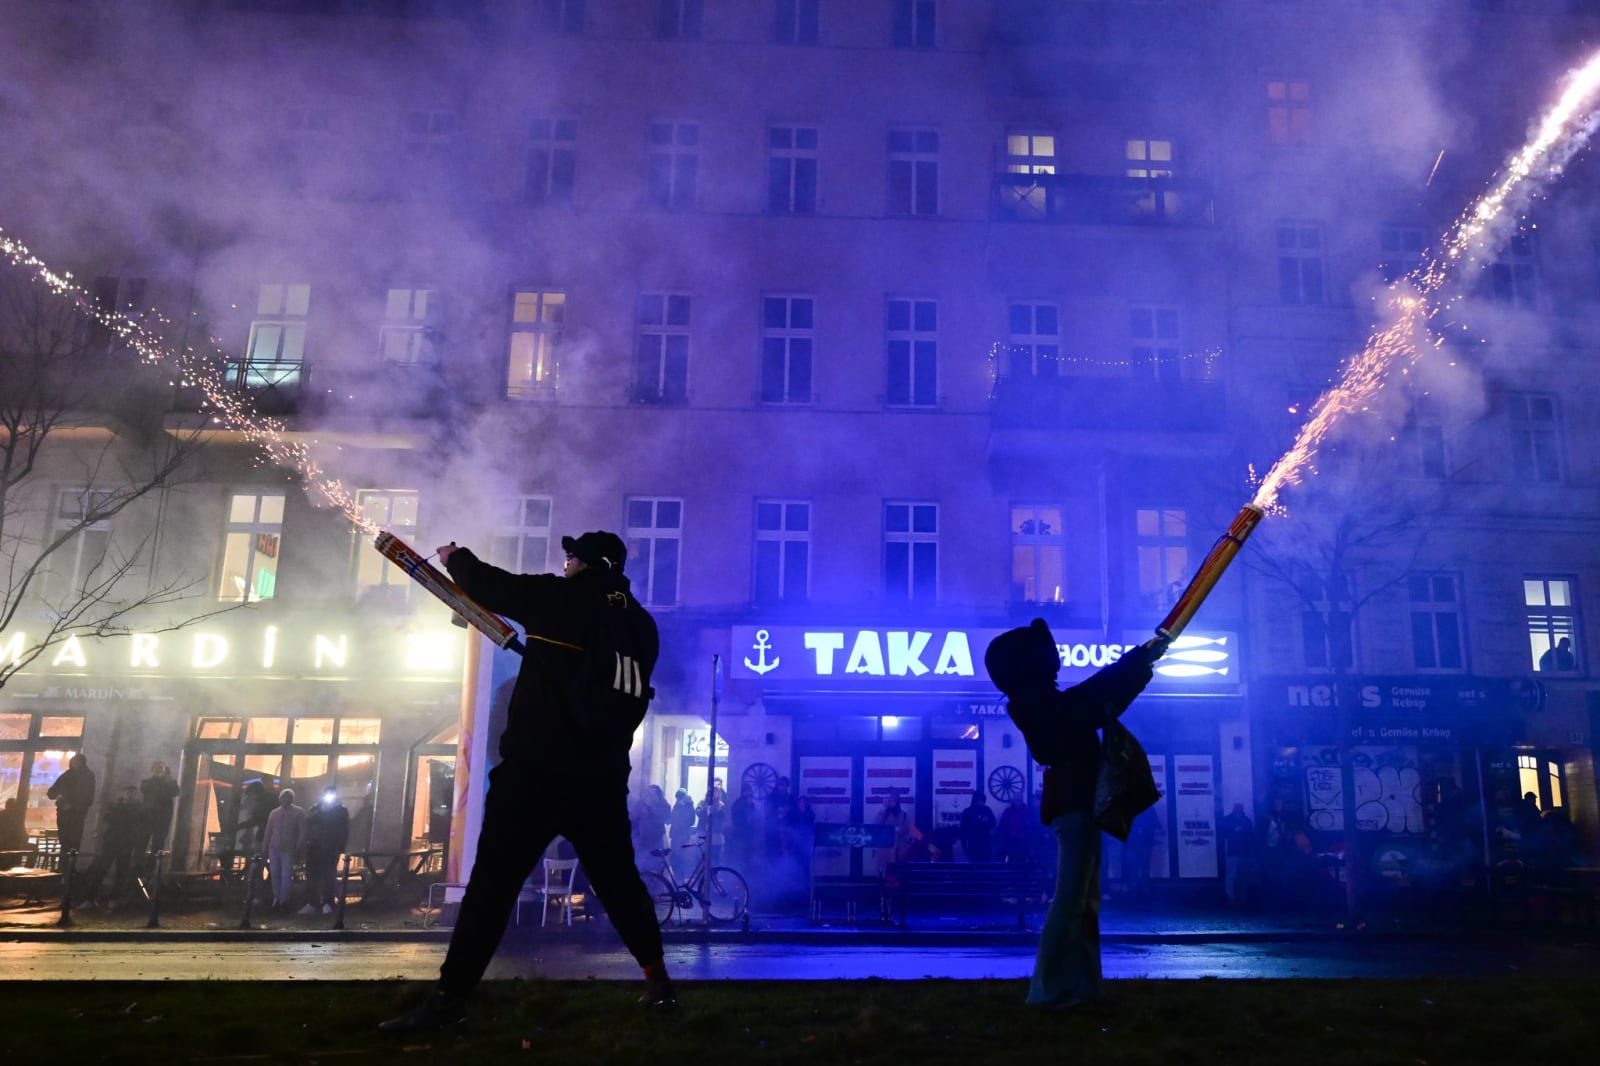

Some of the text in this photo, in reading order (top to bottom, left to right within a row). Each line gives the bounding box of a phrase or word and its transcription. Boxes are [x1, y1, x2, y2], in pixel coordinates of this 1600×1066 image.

[804, 630, 1137, 677] TAKA HOUS
[969, 704, 1006, 715] TAKA
